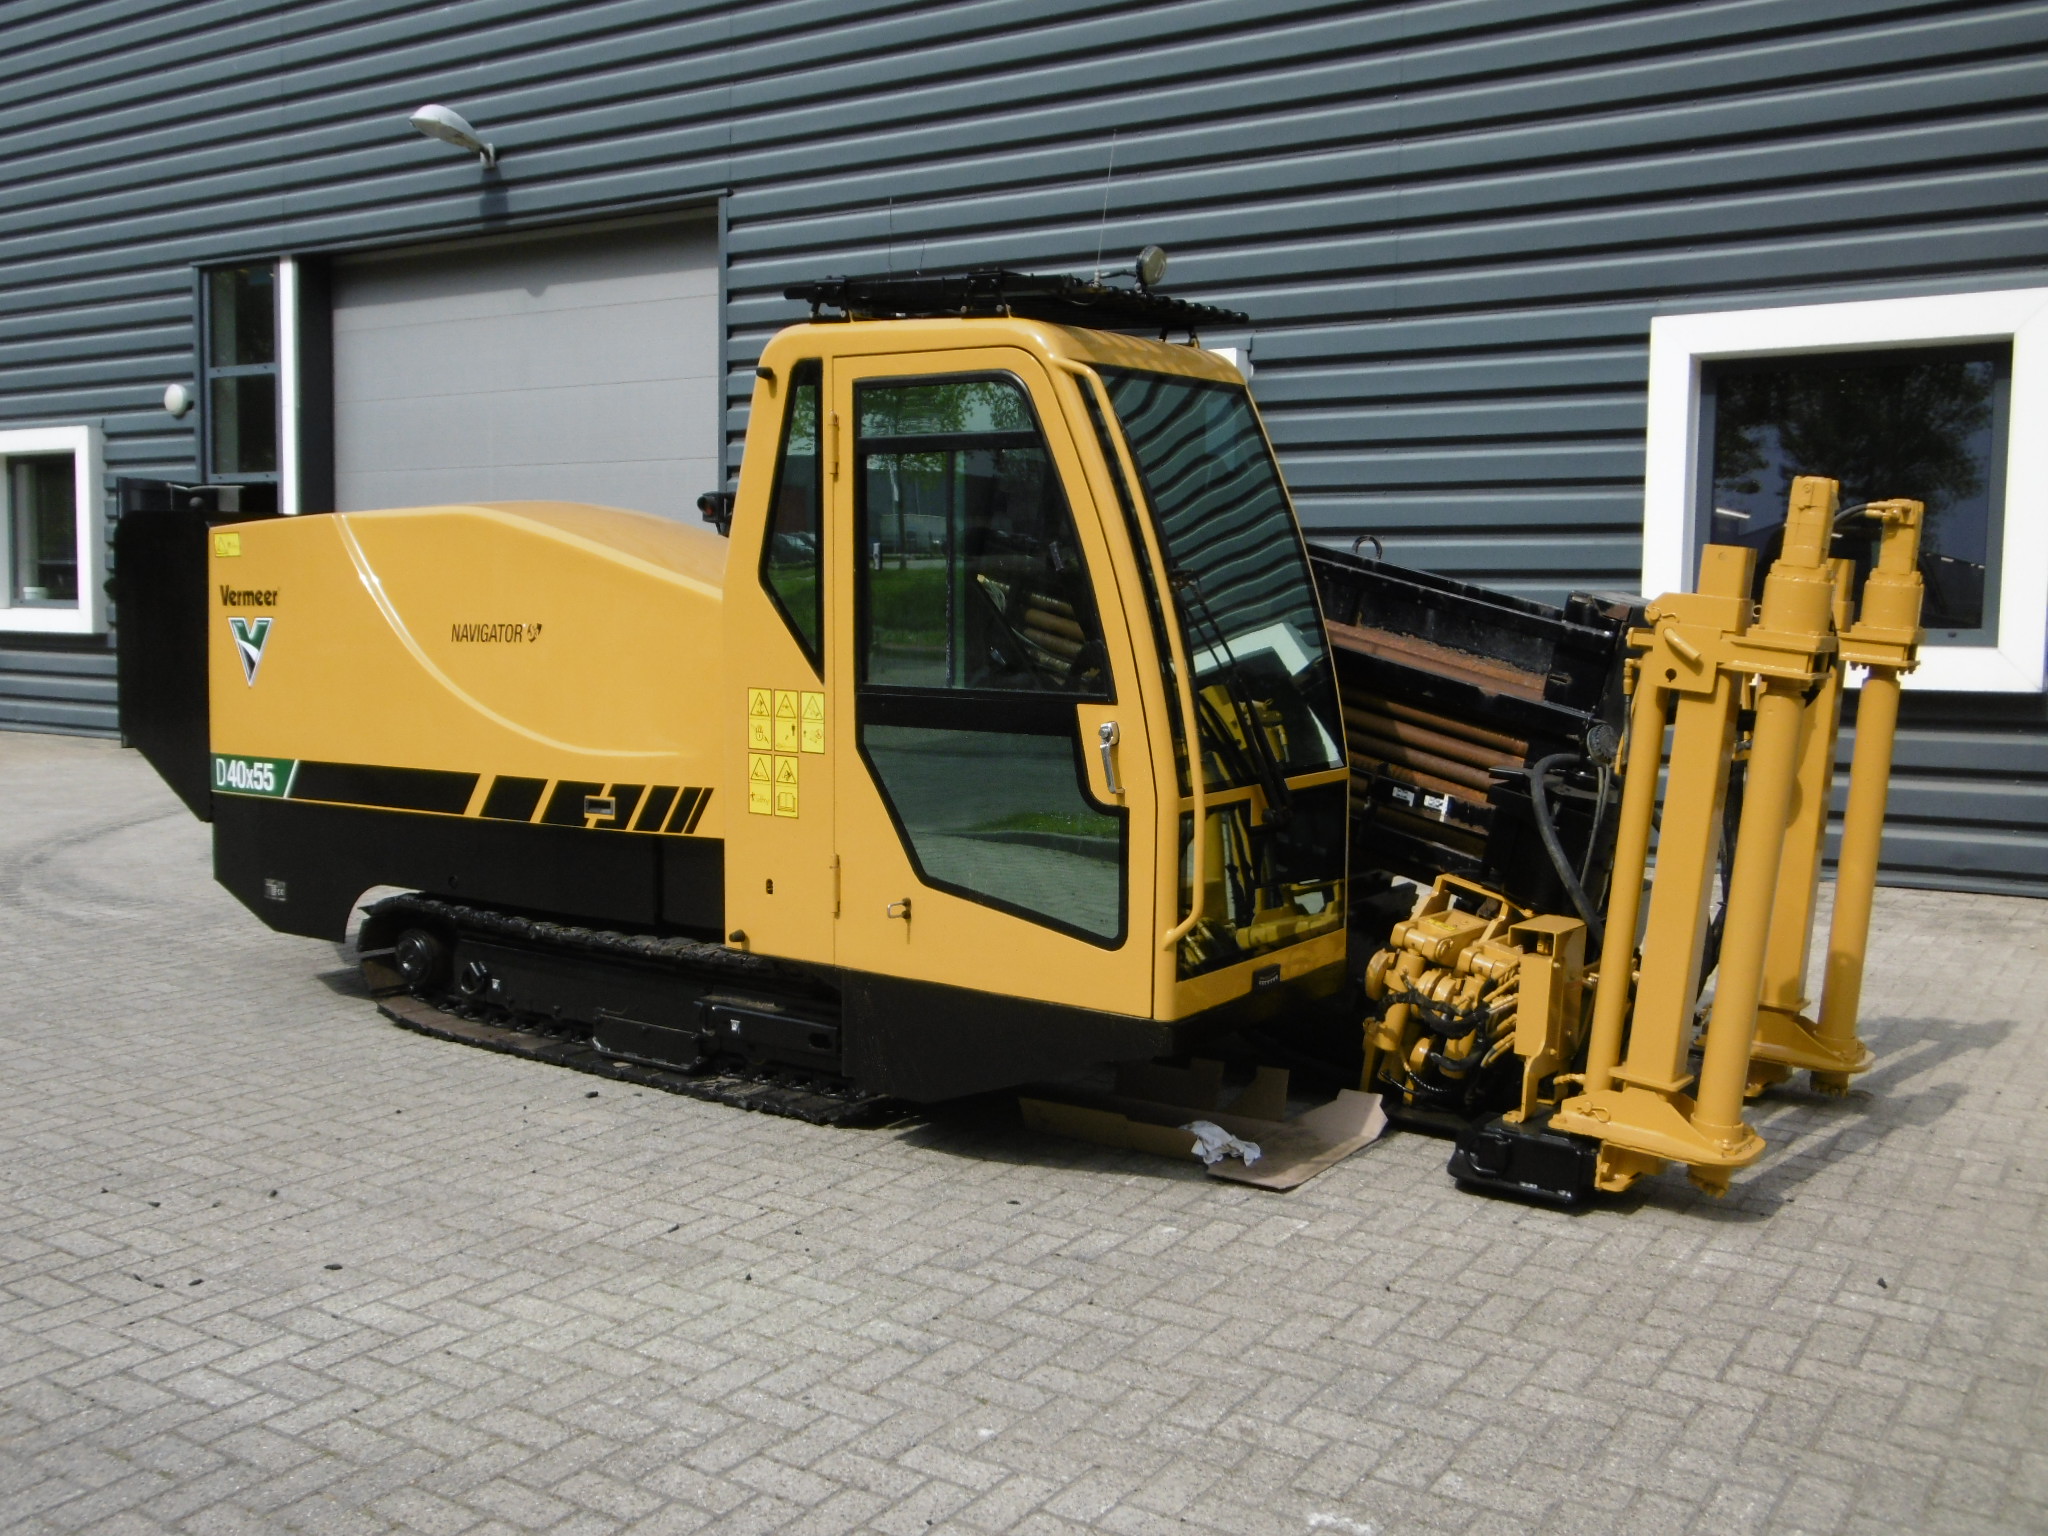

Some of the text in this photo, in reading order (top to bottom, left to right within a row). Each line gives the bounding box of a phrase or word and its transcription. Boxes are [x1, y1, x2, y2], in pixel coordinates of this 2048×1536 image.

[220, 584, 278, 606] Vermeer
[451, 623, 524, 643] NAVIGATOR
[215, 757, 275, 791] D40x55
